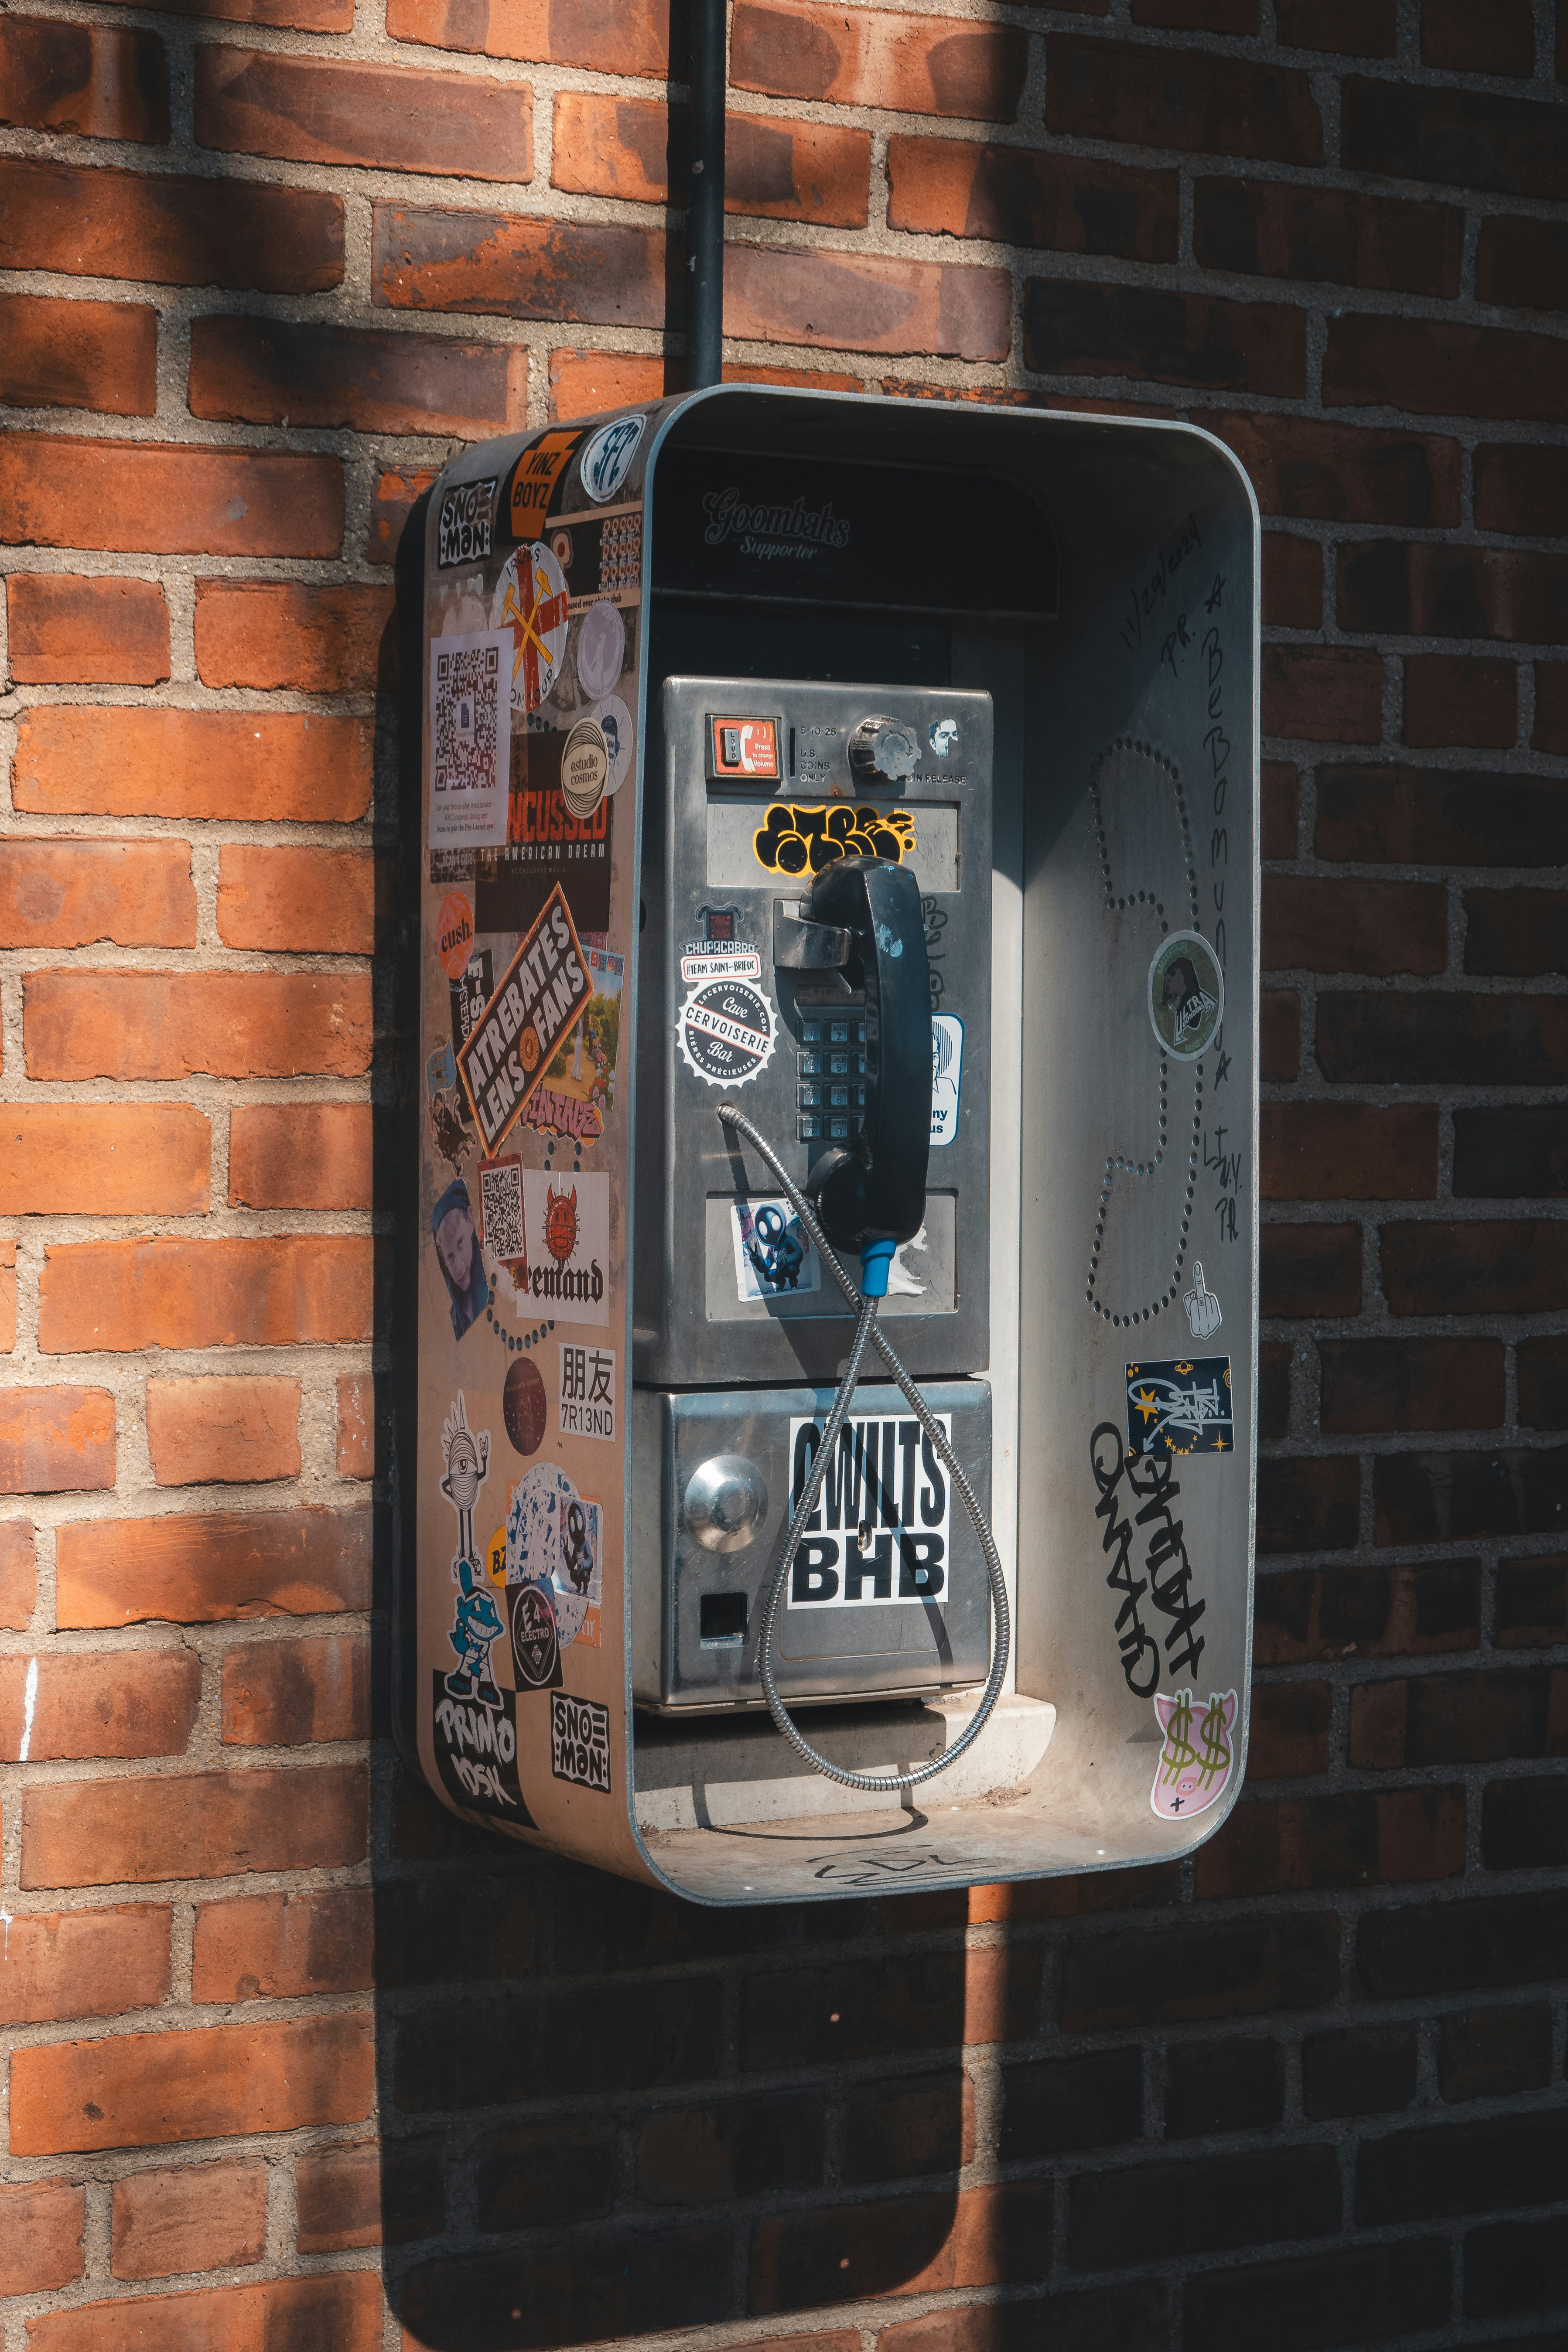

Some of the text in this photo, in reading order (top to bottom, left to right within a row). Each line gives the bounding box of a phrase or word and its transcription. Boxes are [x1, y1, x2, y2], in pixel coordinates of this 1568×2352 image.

[526, 452, 561, 475] YINZ
[512, 481, 550, 509] BOYZ
[703, 487, 850, 547] Goombahs
[740, 536, 817, 560] Supporter
[582, 600, 594, 608] over
[610, 593, 622, 603] club
[570, 754, 598, 772] estudio
[801, 749, 817, 758] U.S.
[801, 761, 830, 770] COINS
[570, 770, 598, 785] cosmos
[800, 773, 826, 782] ONLY
[925, 774, 967, 785] RELEASE
[481, 843, 605, 861] THE AMERICAN DREAM
[685, 940, 756, 955] CHUPACABRA
[687, 960, 755, 975] #TEAM SAINT-BRIEUC
[1157, 942, 1188, 975] SALLERTAINE
[468, 905, 569, 1099] ATREBATES
[698, 984, 767, 1032] LACERVOISERIE.COM
[722, 997, 748, 1018] Cave
[1175, 991, 1217, 1041] ULTRA
[686, 1007, 769, 1053] CERVOISERIE
[836, 1032, 842, 1041] 2
[479, 951, 584, 1144] LENS FANS
[707, 1041, 733, 1063] Bar
[1185, 1037, 1203, 1052] BASKET
[706, 1057, 757, 1076] PRÉCIEUSES
[836, 1064, 842, 1072] 5
[809, 1096, 814, 1105] 7
[837, 1096, 842, 1104] 8
[836, 1127, 842, 1136] 0
[528, 1260, 604, 1304] emand
[562, 1347, 613, 1406] 朋友
[561, 1403, 613, 1436] 7R13ND
[792, 1533, 945, 1603] BHB
[520, 1627, 550, 1642] ELECTRO
[435, 1698, 515, 1766] PRIMO
